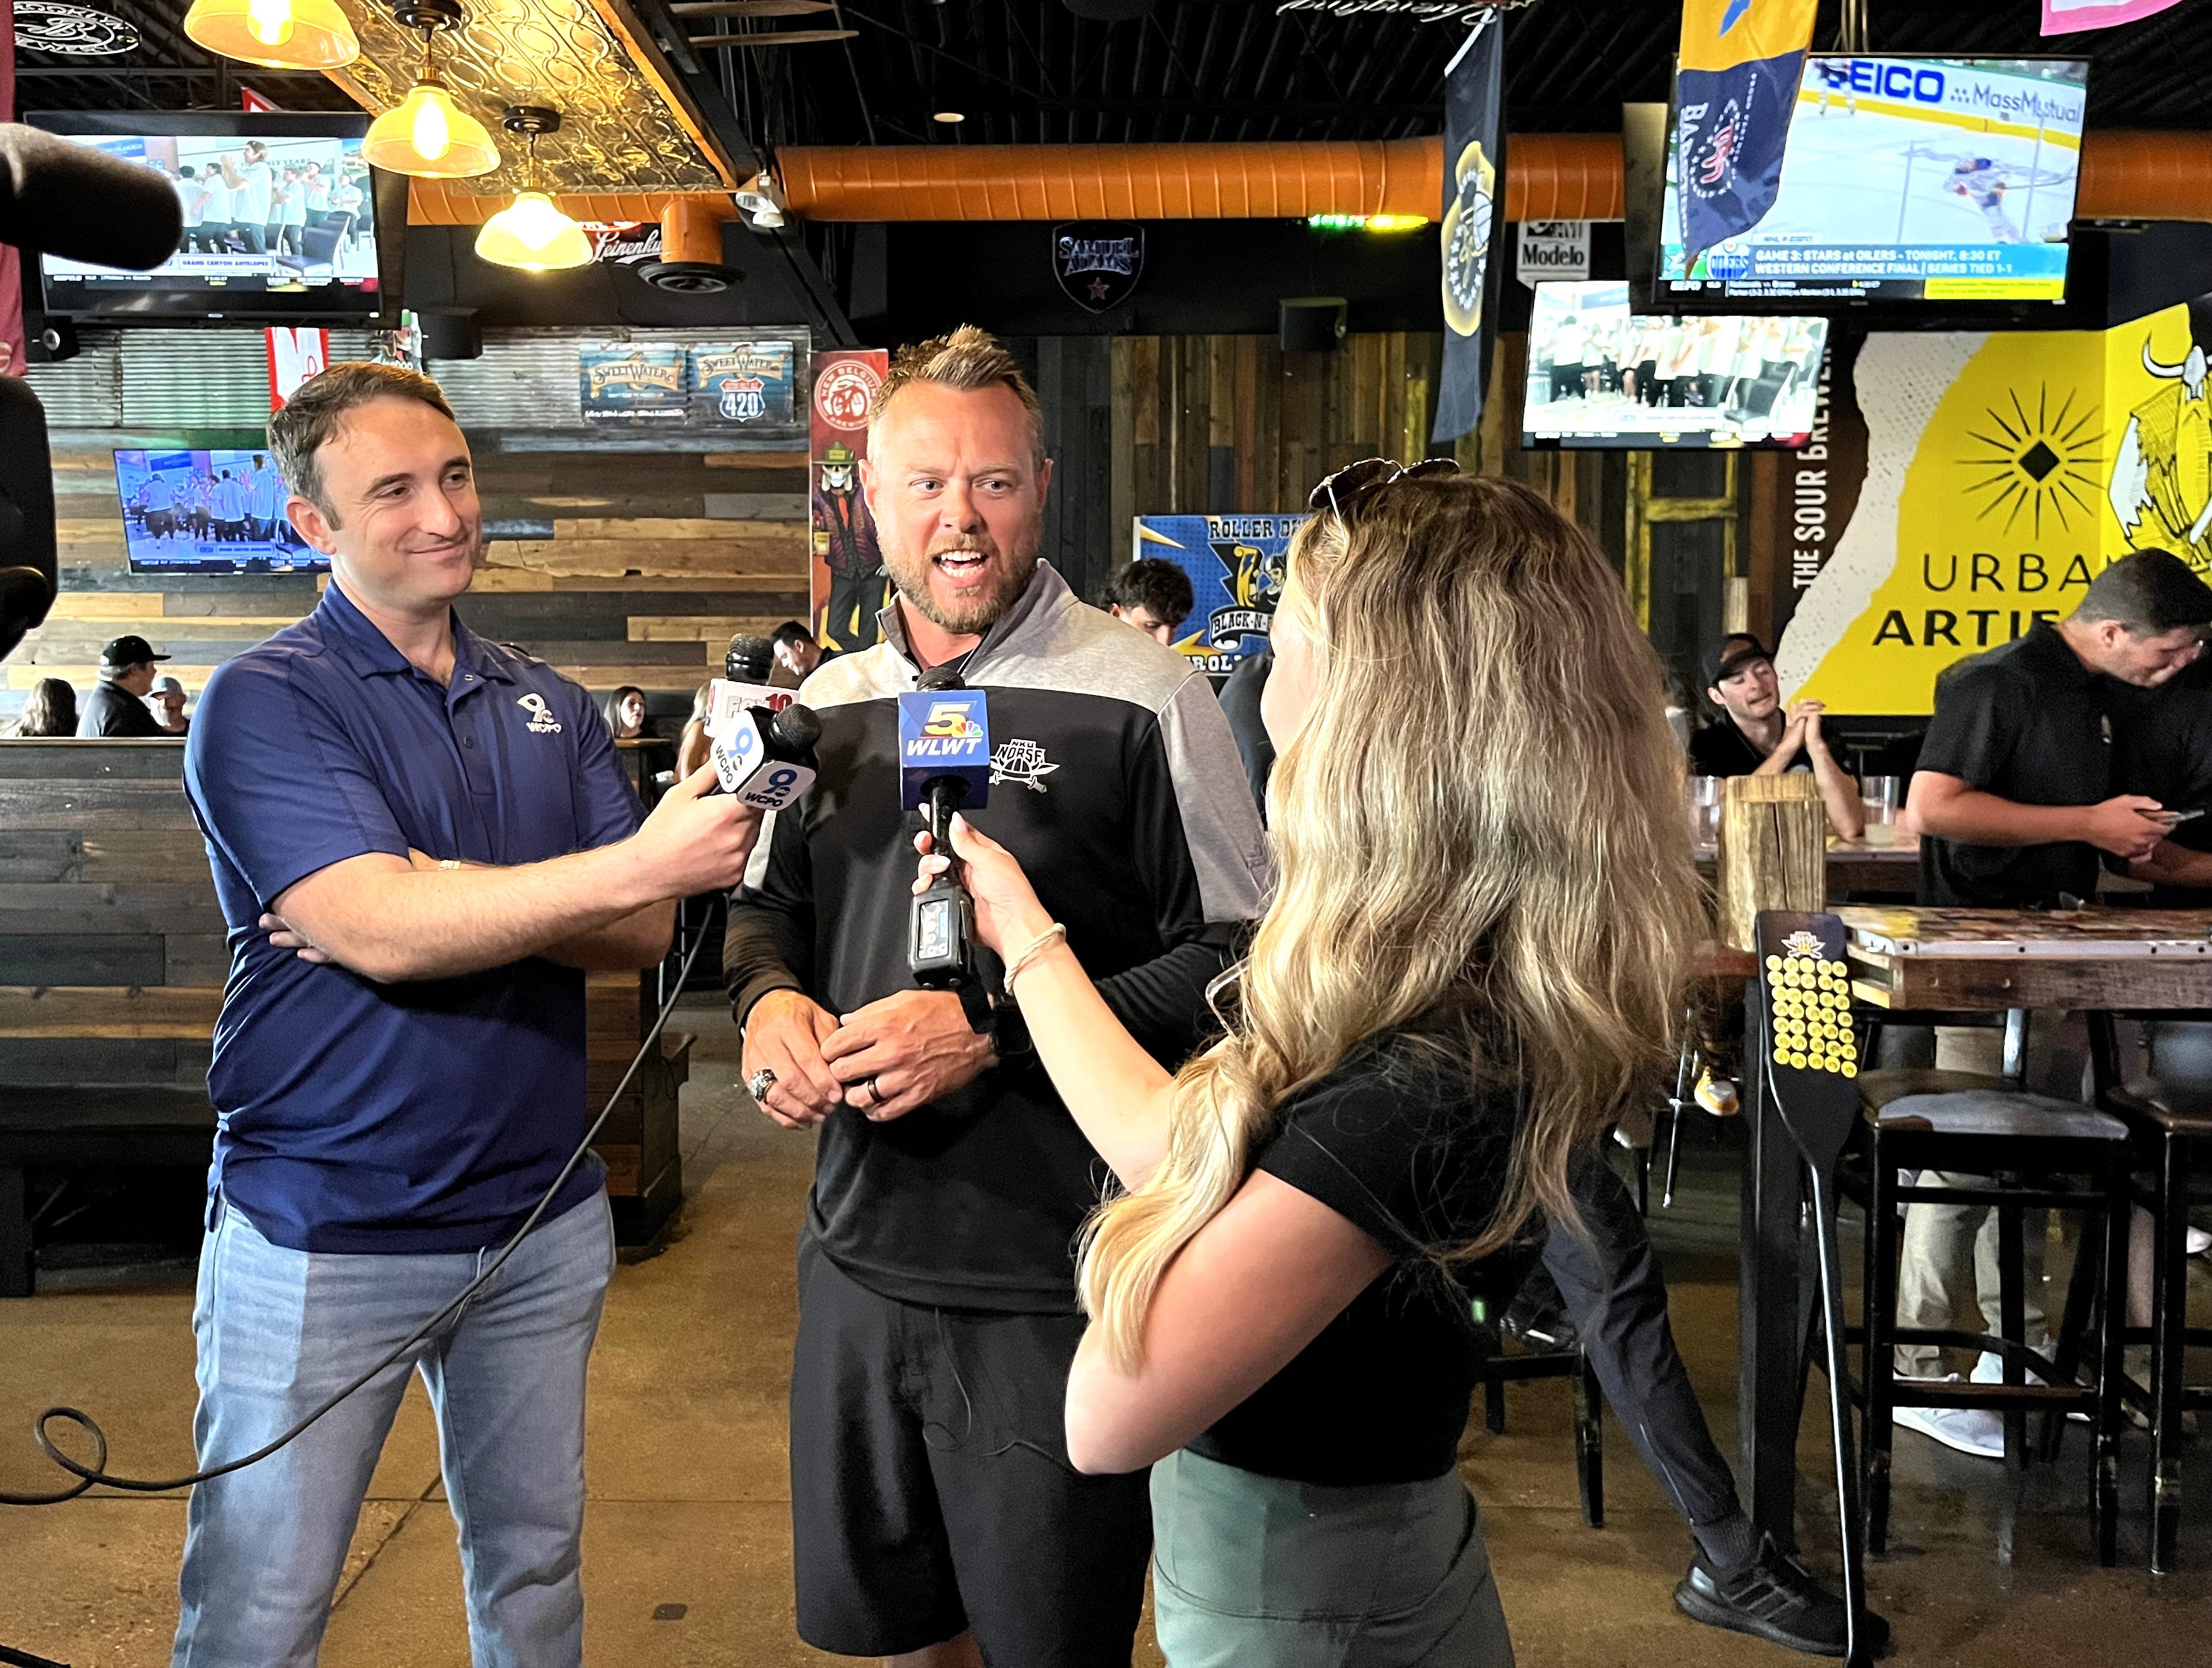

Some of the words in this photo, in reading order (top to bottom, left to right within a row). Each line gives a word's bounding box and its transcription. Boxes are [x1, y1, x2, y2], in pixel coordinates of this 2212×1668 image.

[1827, 60, 1945, 103] EICO
[1059, 237, 1139, 259] SAMUEL
[1522, 243, 1585, 266] Modelo
[1756, 249, 1789, 261] GAME
[1803, 249, 1843, 262] STARS
[1856, 249, 1897, 262] OILERS
[1754, 262, 1811, 274] WESTERN
[1811, 262, 1885, 275] CONFERENCE
[1887, 262, 1919, 274] FINAL
[1927, 263, 1967, 274] SERIES
[820, 373, 836, 398] NEW
[725, 392, 759, 417] 420
[1794, 470, 1827, 542] SOUR
[1210, 520, 1273, 538] ROLLER
[1793, 550, 1819, 589] THE
[1923, 552, 2115, 593] URBA
[924, 702, 971, 737] 5
[727, 727, 753, 759] 9
[907, 738, 983, 756] WLWT
[715, 744, 734, 784] WCPO
[762, 768, 798, 794] 9
[744, 791, 784, 807] WCPO
